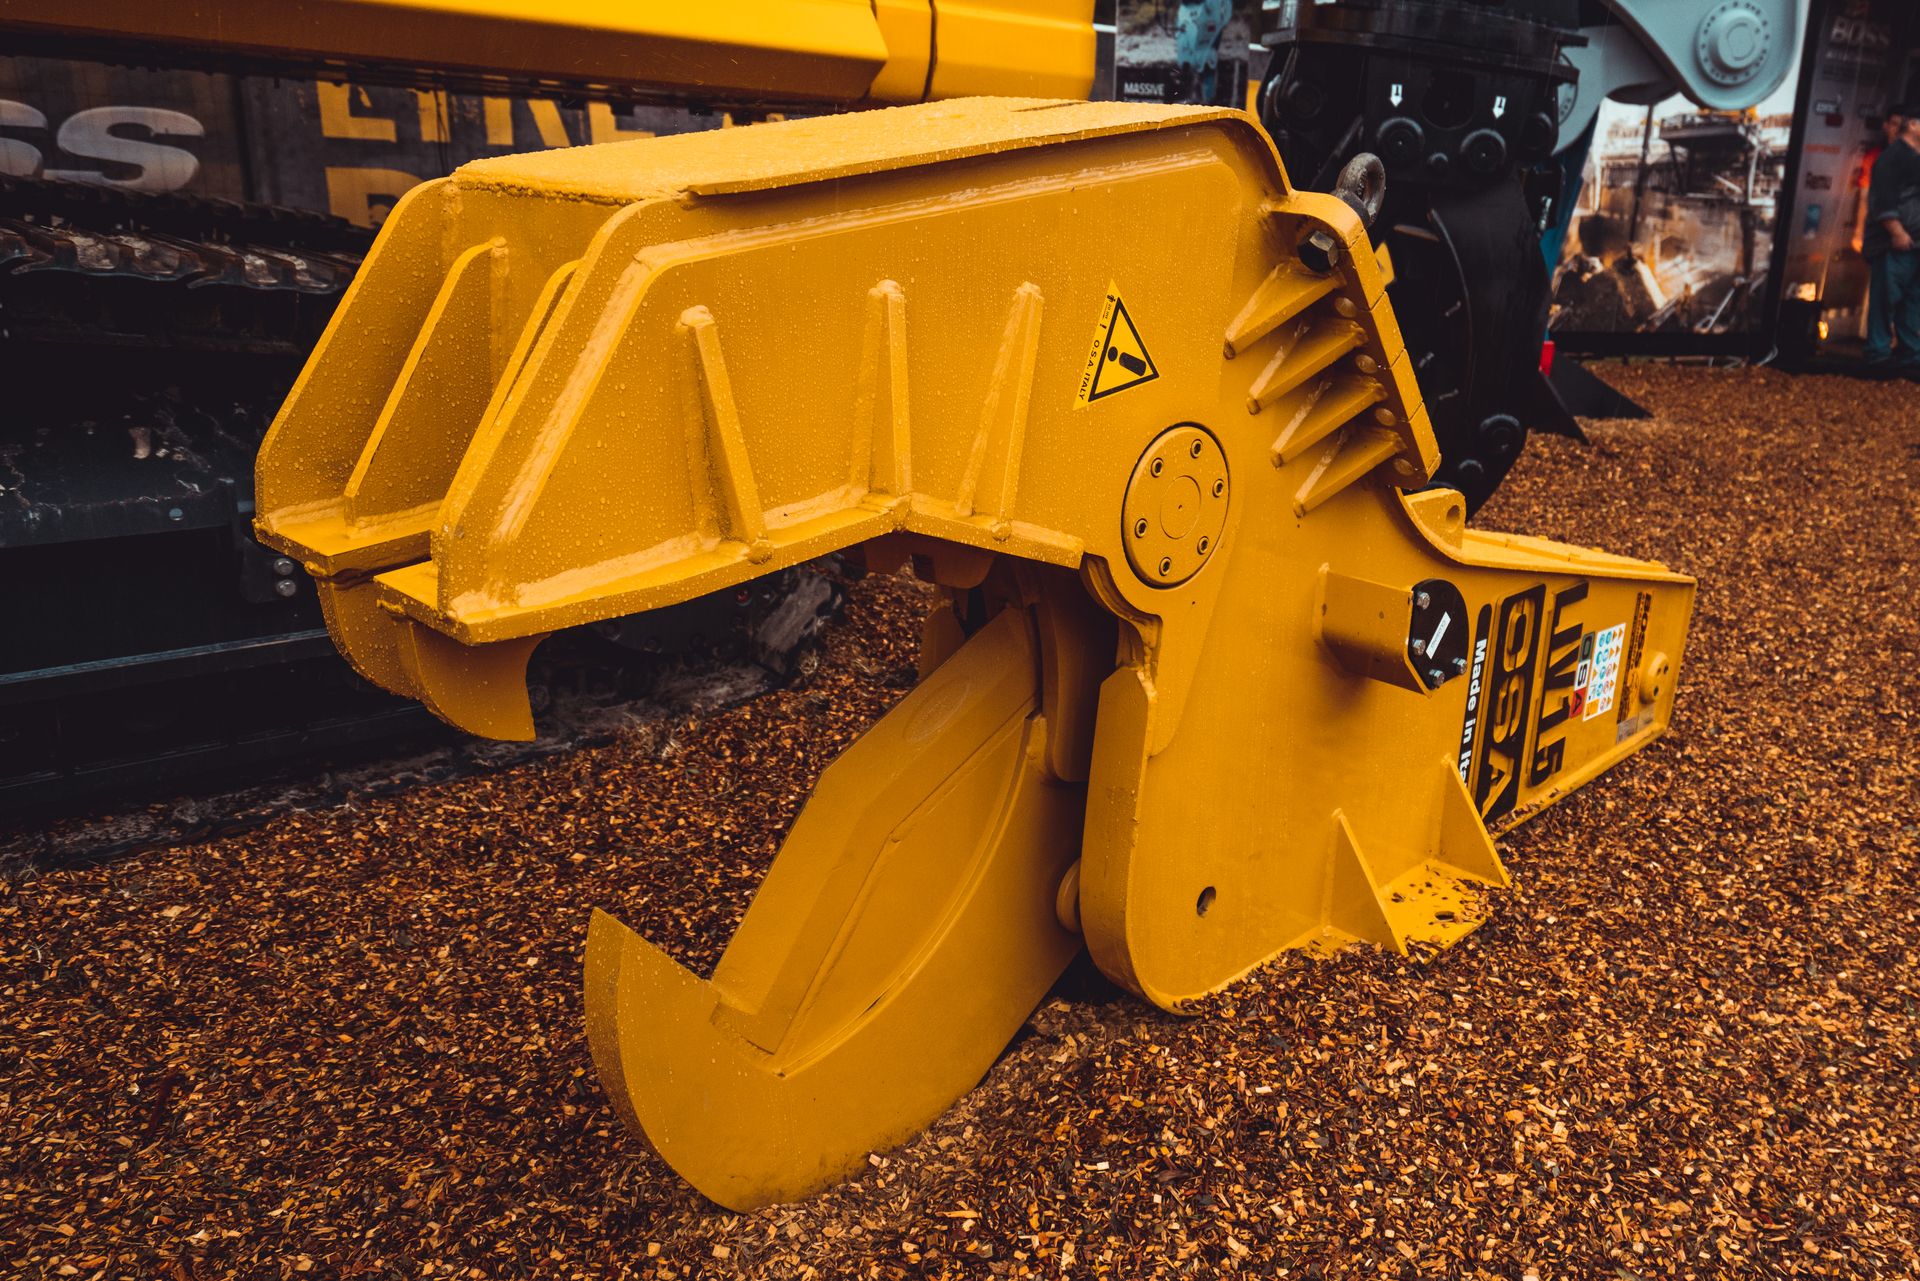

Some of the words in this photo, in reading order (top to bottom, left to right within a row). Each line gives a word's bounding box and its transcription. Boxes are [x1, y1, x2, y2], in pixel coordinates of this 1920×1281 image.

[1124, 82, 1165, 96] MASSIVE
[1078, 372, 1091, 400] ITALY
[1467, 638, 1487, 712] Made
[1572, 633, 1594, 715] OSA
[1463, 718, 1477, 744] in
[1482, 598, 1536, 819] OSA
